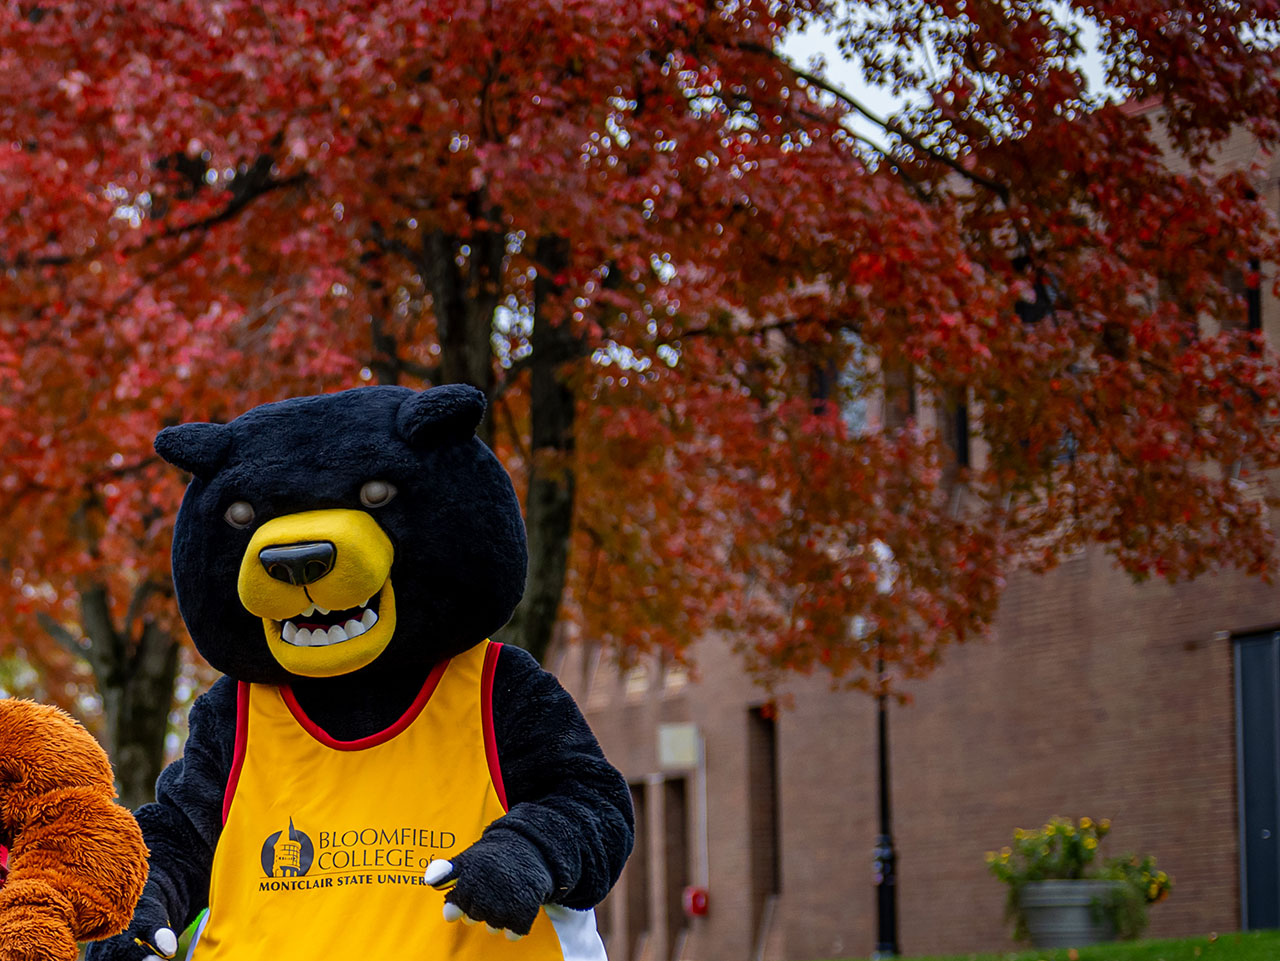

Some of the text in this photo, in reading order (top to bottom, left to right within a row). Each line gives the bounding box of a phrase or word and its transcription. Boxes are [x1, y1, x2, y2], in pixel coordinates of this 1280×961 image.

[319, 828, 456, 849] BLOOMFIELD
[318, 849, 414, 870] COLLEGE
[258, 874, 426, 892] MONTCLAIR STATE UNIVER
